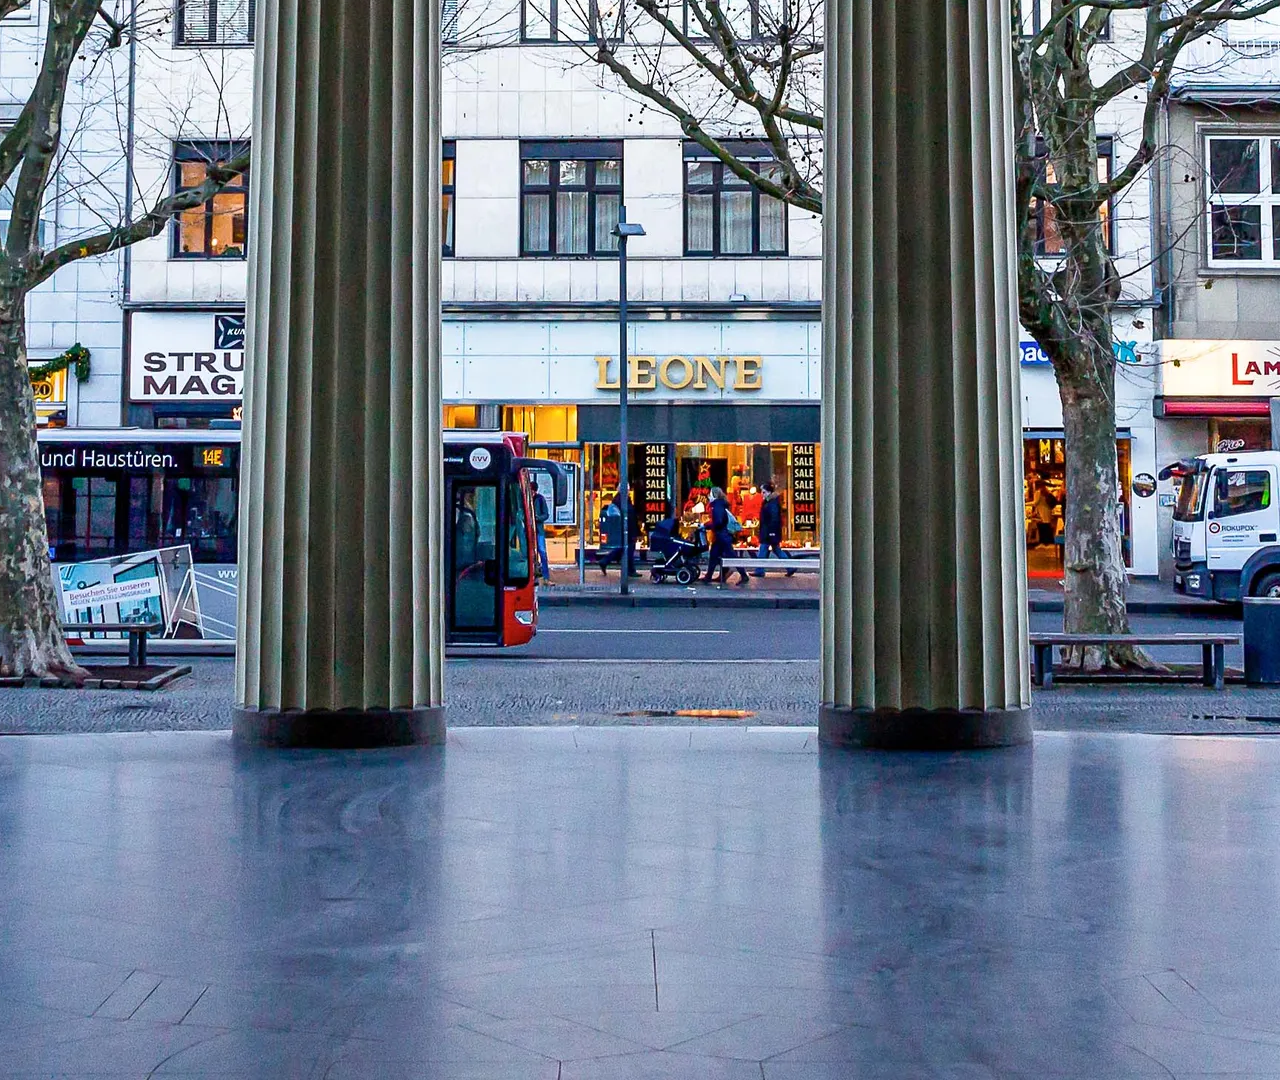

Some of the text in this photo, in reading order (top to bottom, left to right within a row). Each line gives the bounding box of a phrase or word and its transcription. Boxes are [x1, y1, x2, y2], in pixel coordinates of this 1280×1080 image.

[594, 356, 763, 390] LEONE
[143, 375, 243, 395] MAG
[646, 445, 665, 454] SALE
[794, 445, 813, 455] SALE
[41, 450, 75, 467] und
[82, 450, 178, 468] Haustüren.
[646, 457, 665, 466] SALE
[794, 457, 813, 466] SALE
[646, 468, 665, 477] SALE
[794, 469, 814, 478] SALE
[646, 480, 665, 488] SALE
[795, 480, 814, 489] SALE
[646, 491, 665, 500] SALE
[795, 492, 814, 501] SALE
[646, 502, 665, 511] SALE
[795, 503, 814, 513] SALE
[796, 515, 814, 524] SALE
[69, 581, 151, 601] Besuchen Sie unseren
